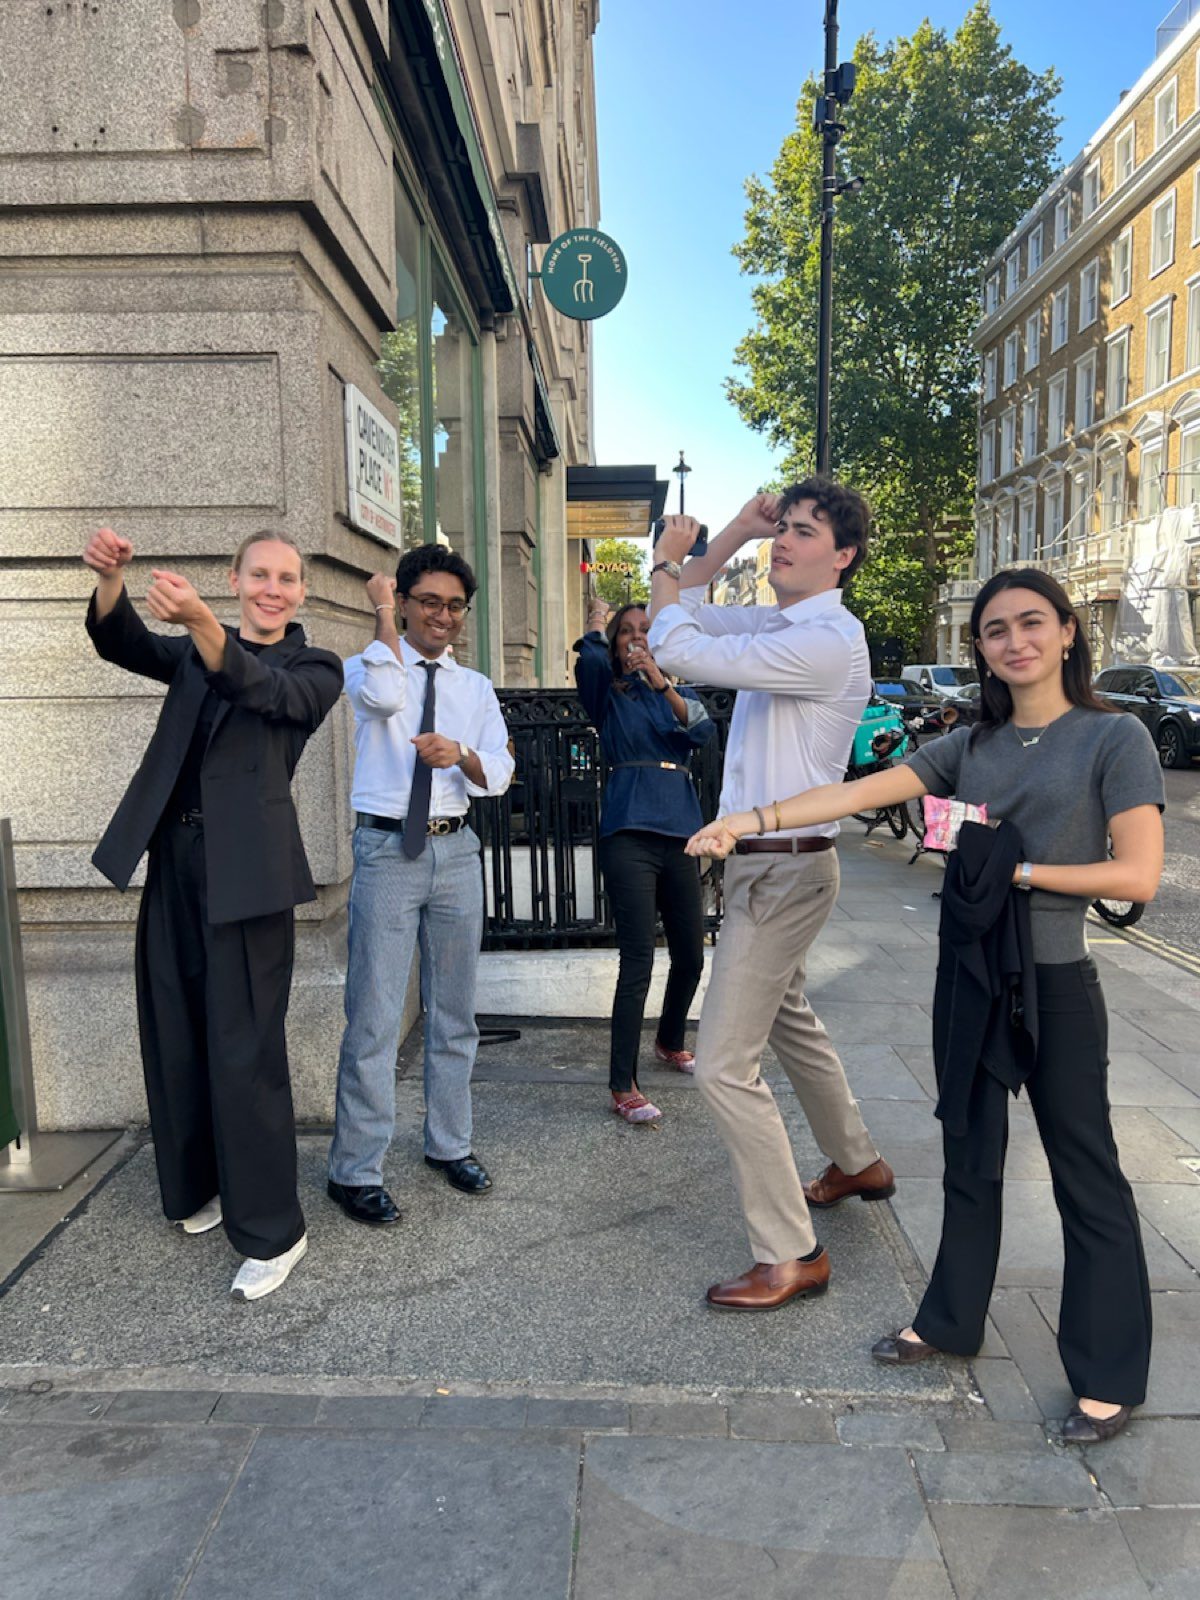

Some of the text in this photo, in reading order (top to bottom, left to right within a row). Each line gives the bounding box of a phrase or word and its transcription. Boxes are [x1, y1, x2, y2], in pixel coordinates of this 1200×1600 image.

[548, 248, 561, 273] HOME
[561, 239, 572, 249] OF
[592, 236, 622, 273] FIELDTRAY
[357, 405, 396, 468] CAVENDISH
[359, 448, 393, 503] PLACE W1
